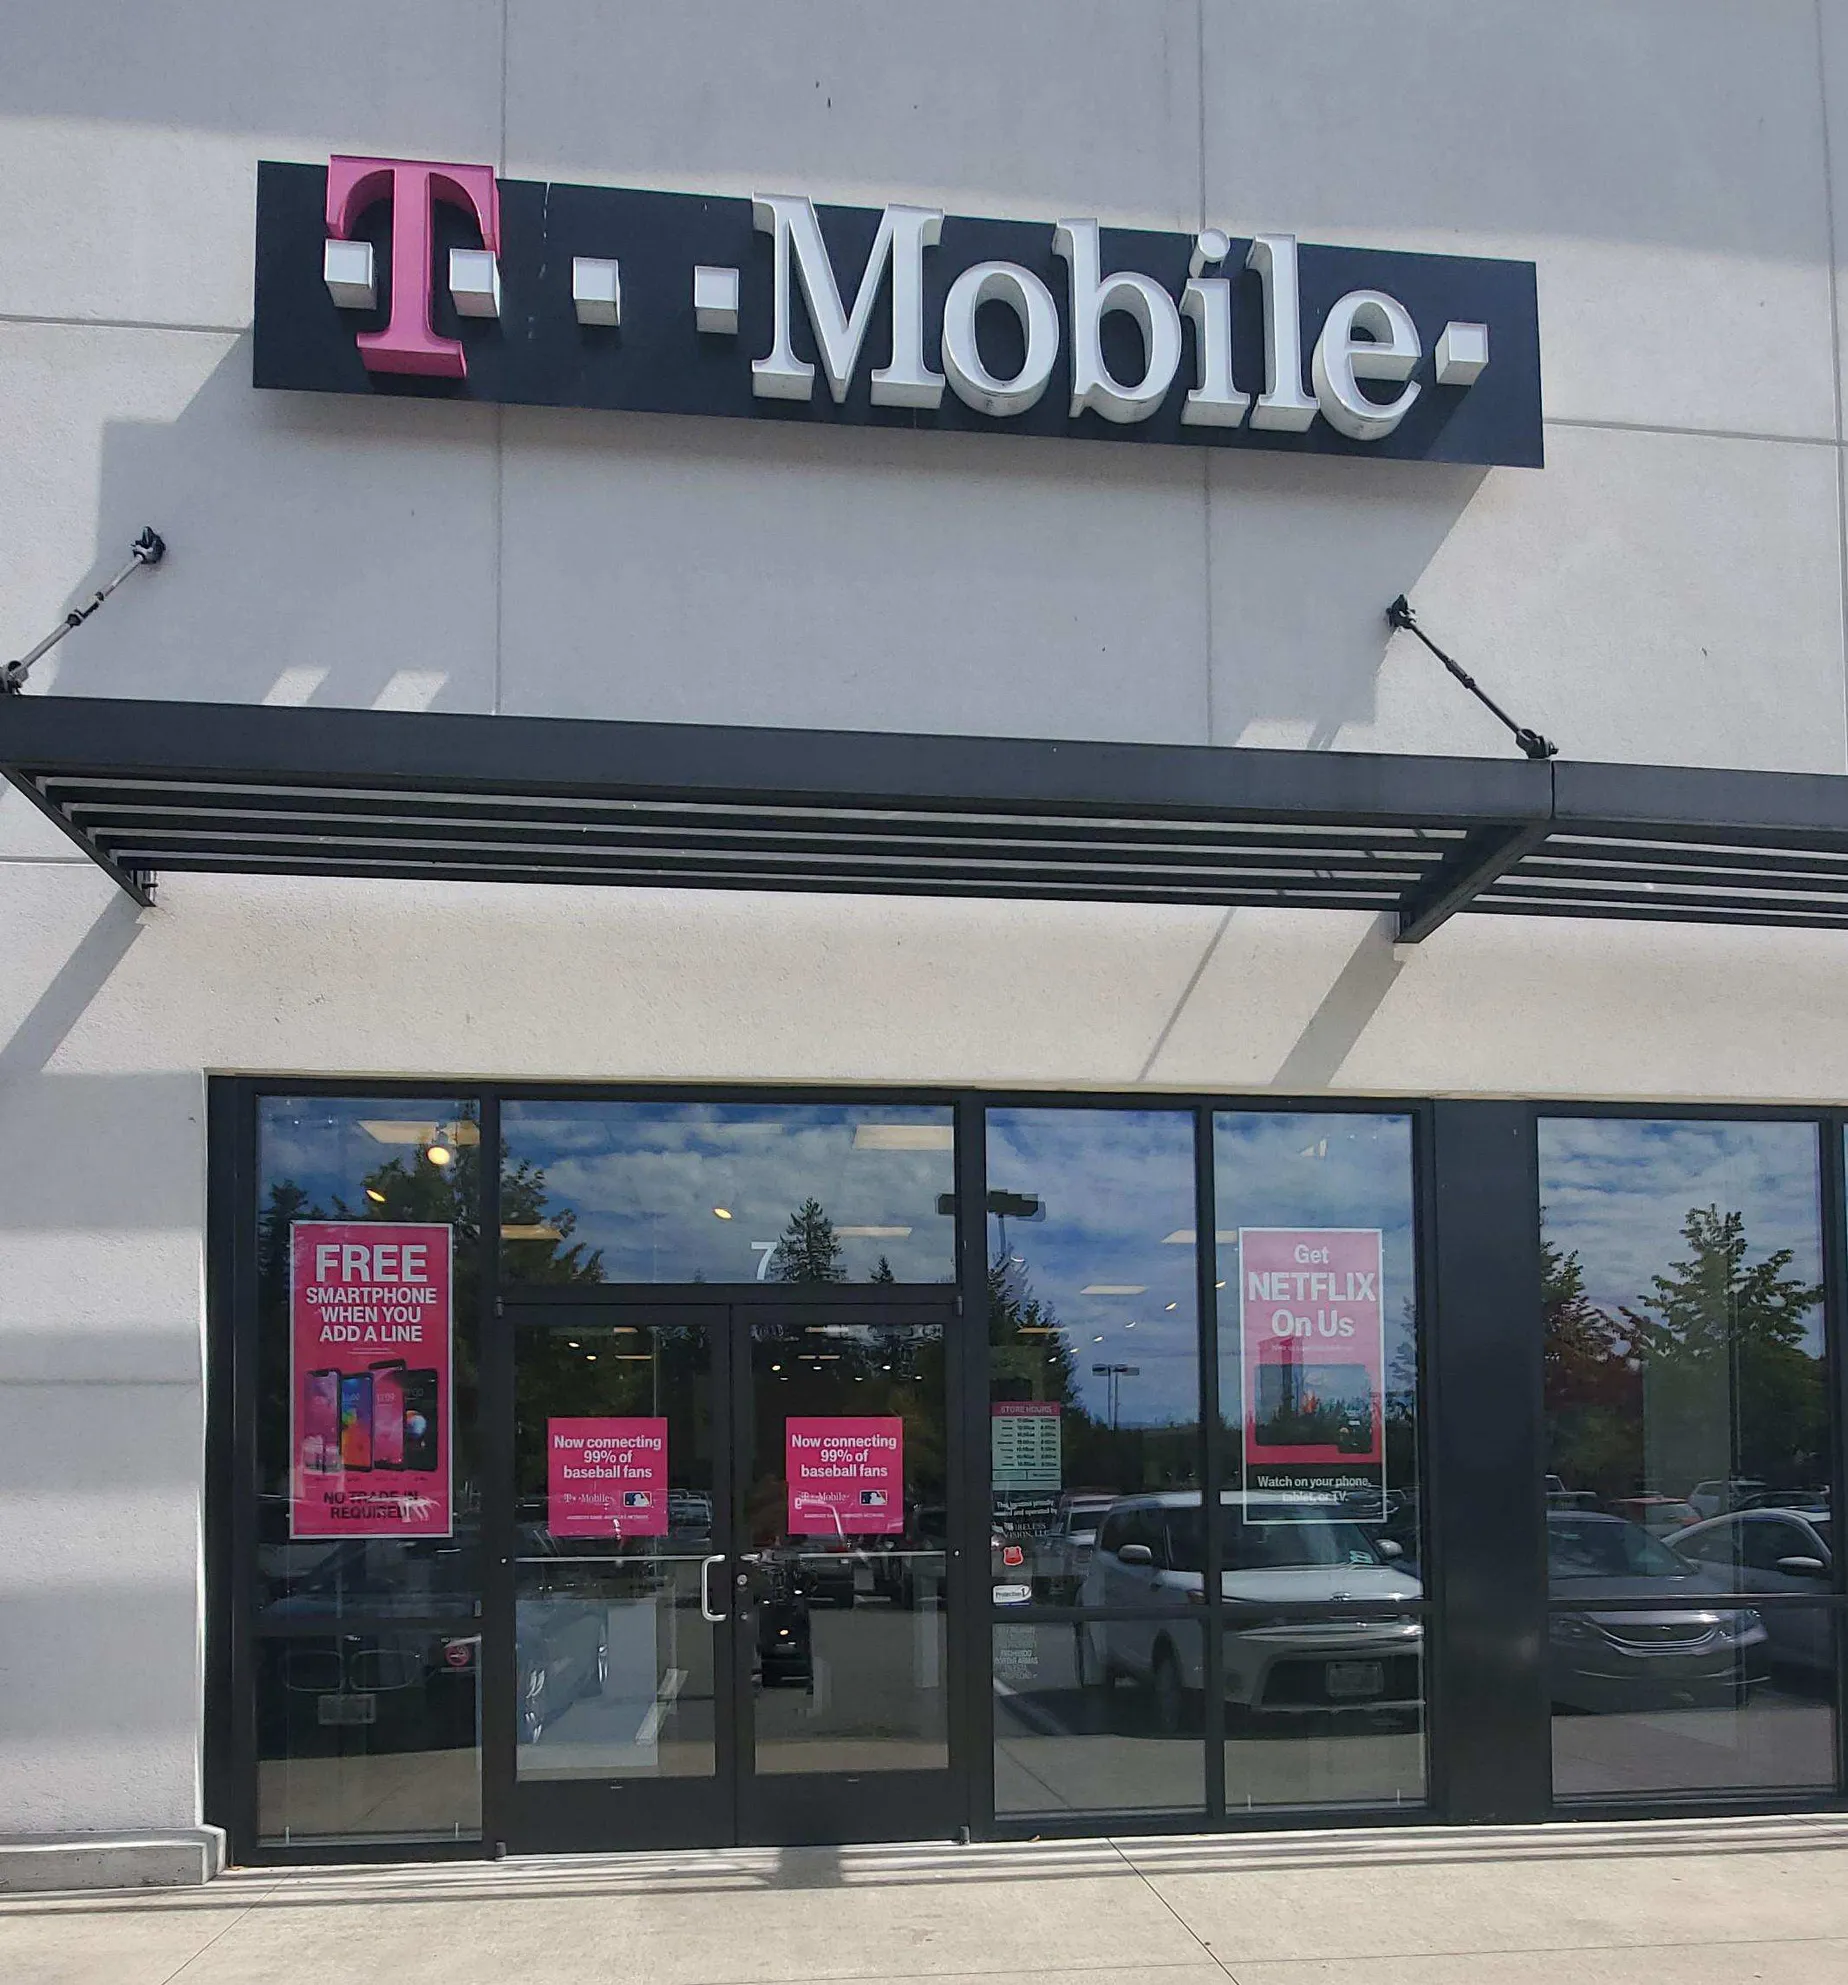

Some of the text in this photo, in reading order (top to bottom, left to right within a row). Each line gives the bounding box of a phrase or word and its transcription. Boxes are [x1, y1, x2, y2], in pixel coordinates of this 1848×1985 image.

[751, 1241, 777, 1280] 7
[1294, 1244, 1331, 1264] Get
[316, 1244, 427, 1282] FREE
[1248, 1271, 1377, 1301] NETFLIX
[306, 1287, 437, 1304] SMARTPHONE
[321, 1306, 421, 1323] WHEN YOU
[1272, 1309, 1355, 1338] On Us
[319, 1325, 422, 1342] ADD A LINE
[554, 1435, 661, 1451] Now connecting
[791, 1434, 897, 1450] Now connecting
[584, 1450, 633, 1463] 99% of
[821, 1449, 869, 1463] 99% of
[563, 1465, 653, 1479] baseball fans
[801, 1464, 888, 1478] baseball fans
[1257, 1476, 1292, 1488] Watch
[1294, 1478, 1308, 1488] on
[1310, 1478, 1334, 1489] your
[324, 1491, 346, 1505] NO
